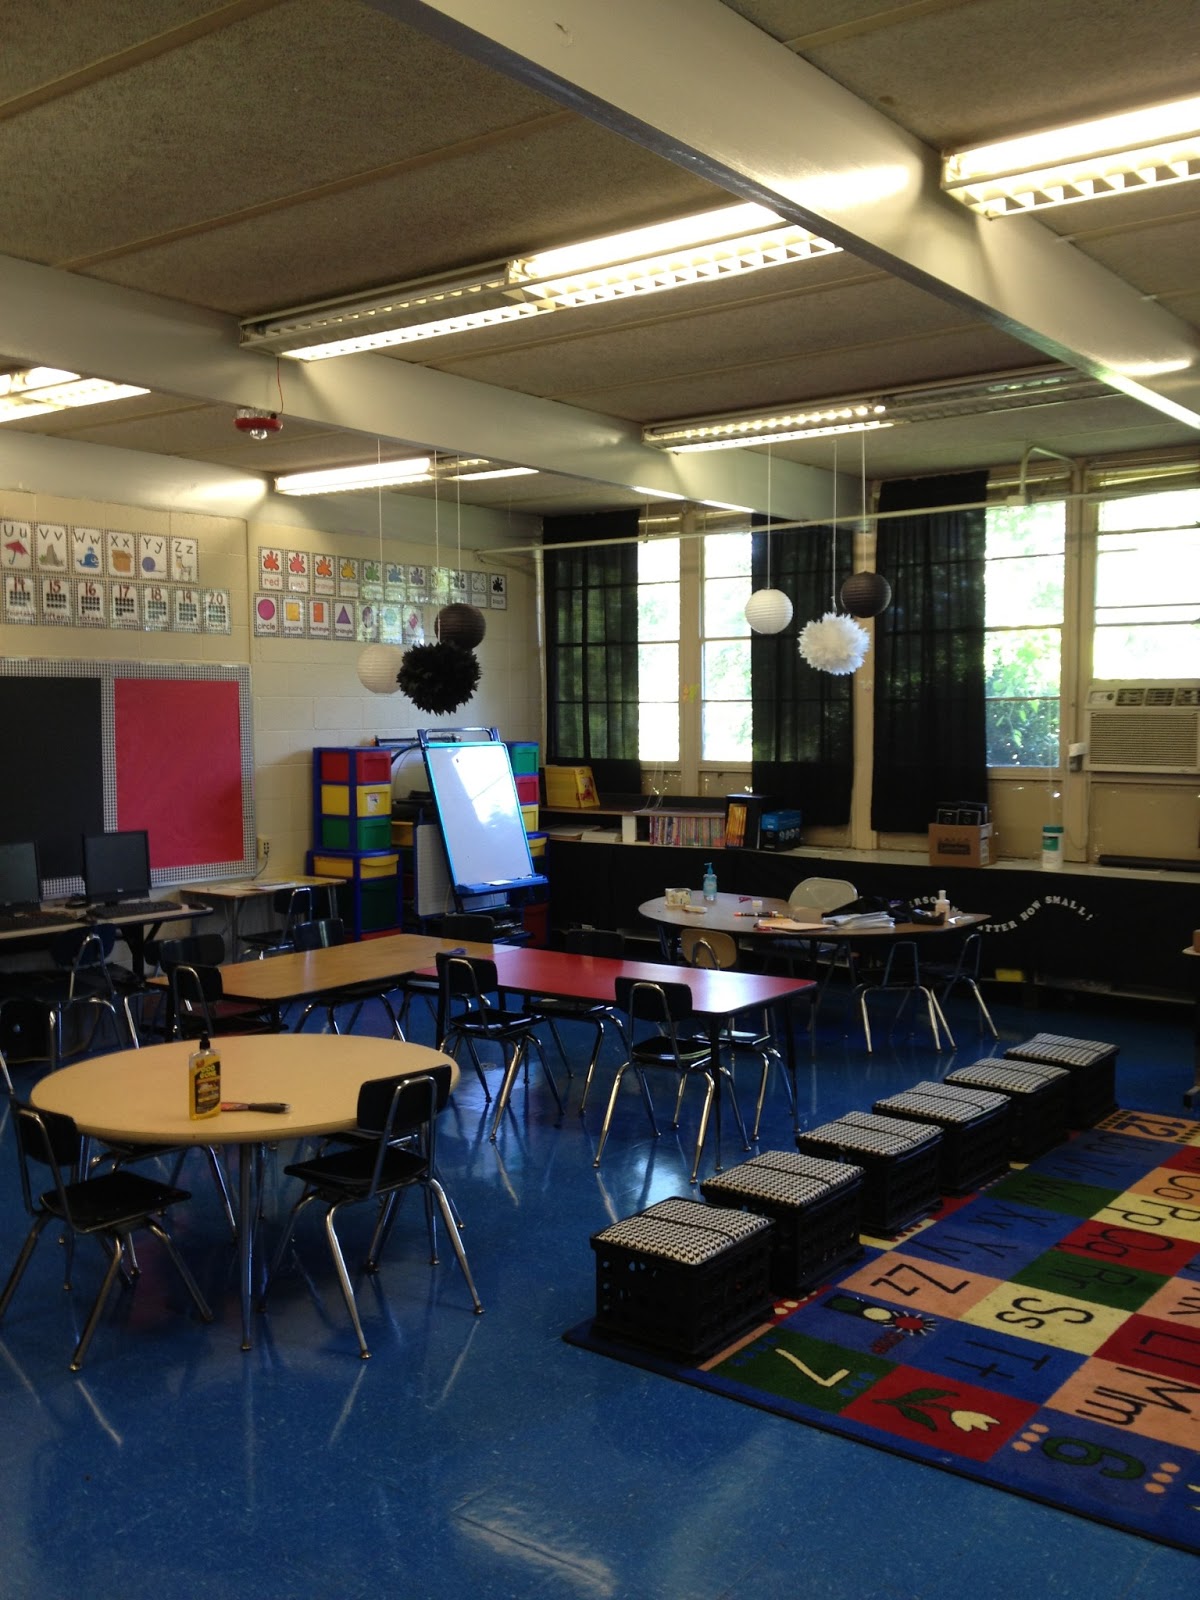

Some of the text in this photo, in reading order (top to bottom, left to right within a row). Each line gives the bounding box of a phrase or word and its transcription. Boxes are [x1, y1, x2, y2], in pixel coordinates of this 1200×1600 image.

[14, 576, 26, 592] 14
[49, 580, 61, 594] 15
[85, 582, 96, 596] 16
[264, 577, 279, 587] red
[119, 584, 130, 598] 17
[151, 586, 162, 601] 18
[182, 589, 192, 603] 19
[210, 592, 223, 605] 20
[258, 622, 275, 631] circle
[1019, 900, 1042, 921] HOW
[1112, 1115, 1187, 1138] 12
[775, 1348, 850, 1388] 7
